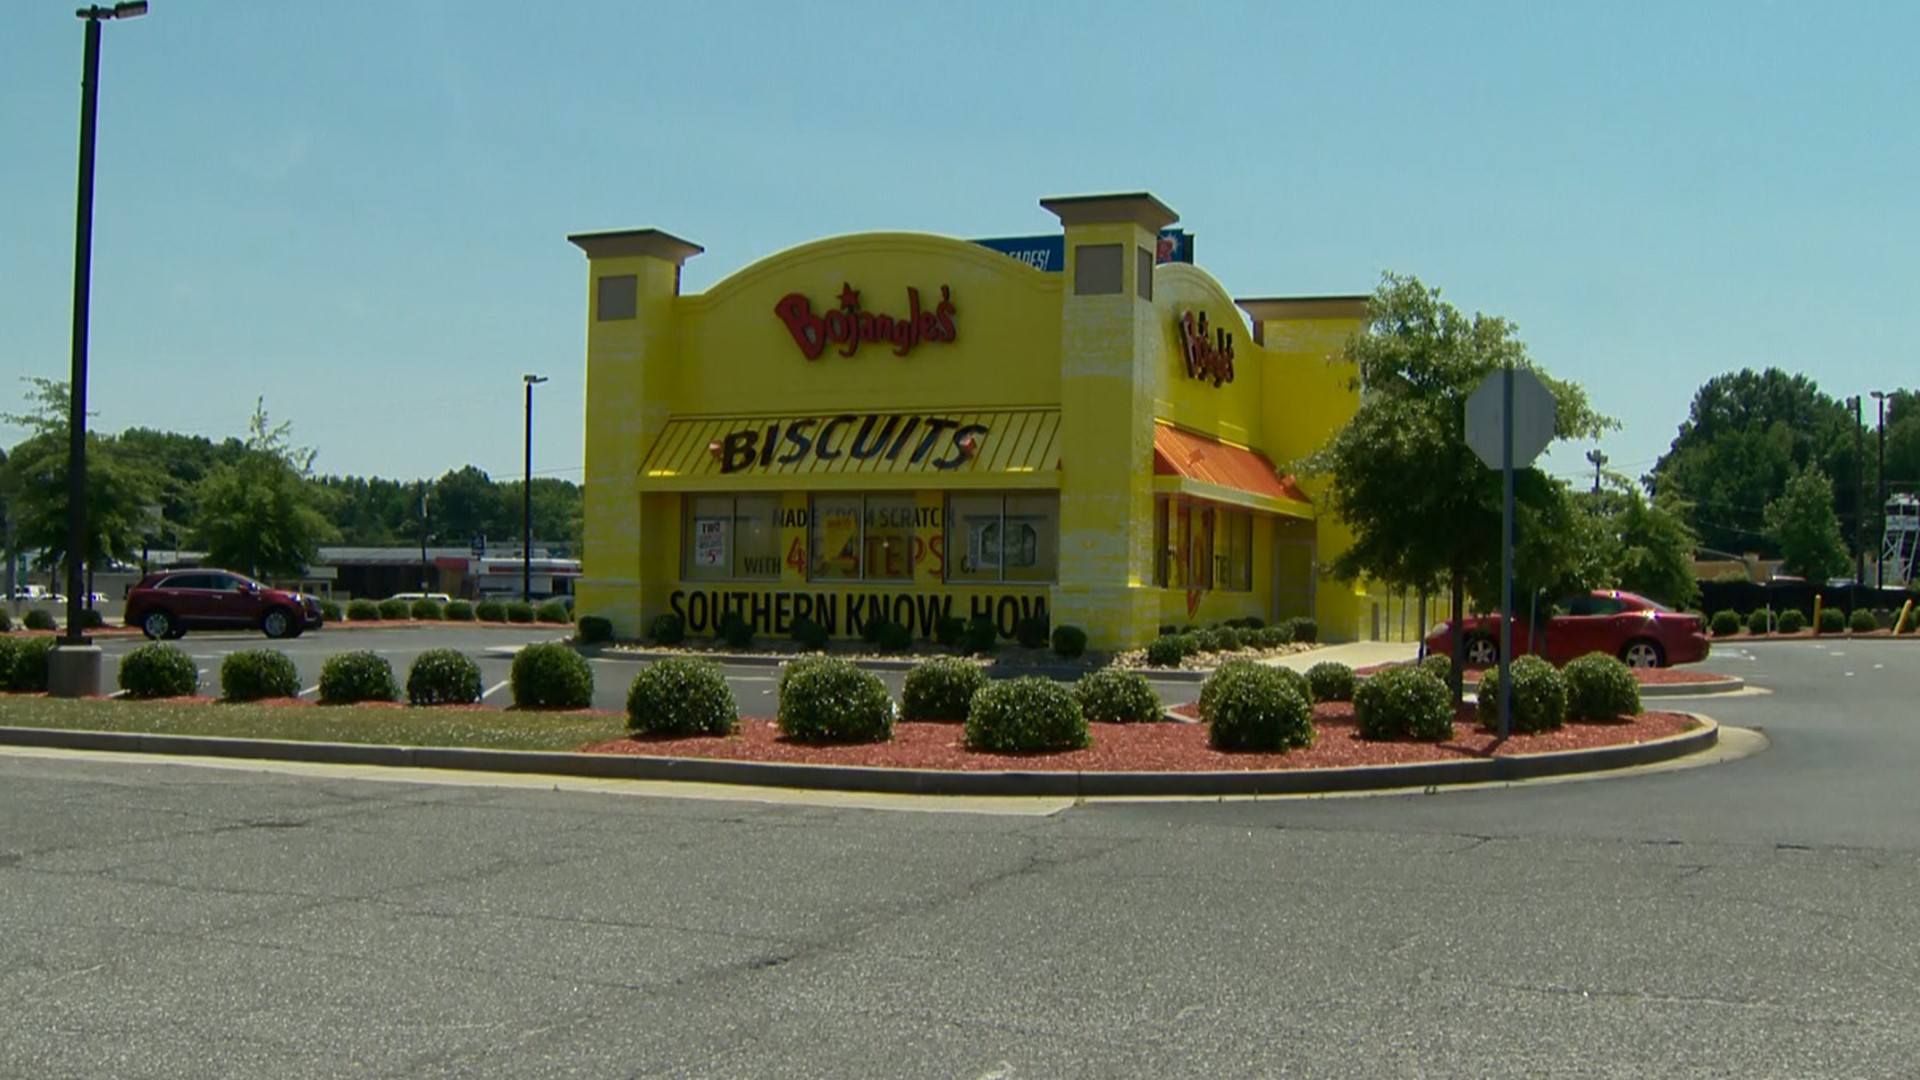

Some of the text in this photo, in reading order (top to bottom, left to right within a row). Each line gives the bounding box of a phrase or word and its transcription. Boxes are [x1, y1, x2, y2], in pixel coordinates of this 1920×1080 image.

[720, 414, 988, 474] BISCUITS
[744, 556, 782, 574] WITH
[669, 588, 837, 636] SOUTHERN
